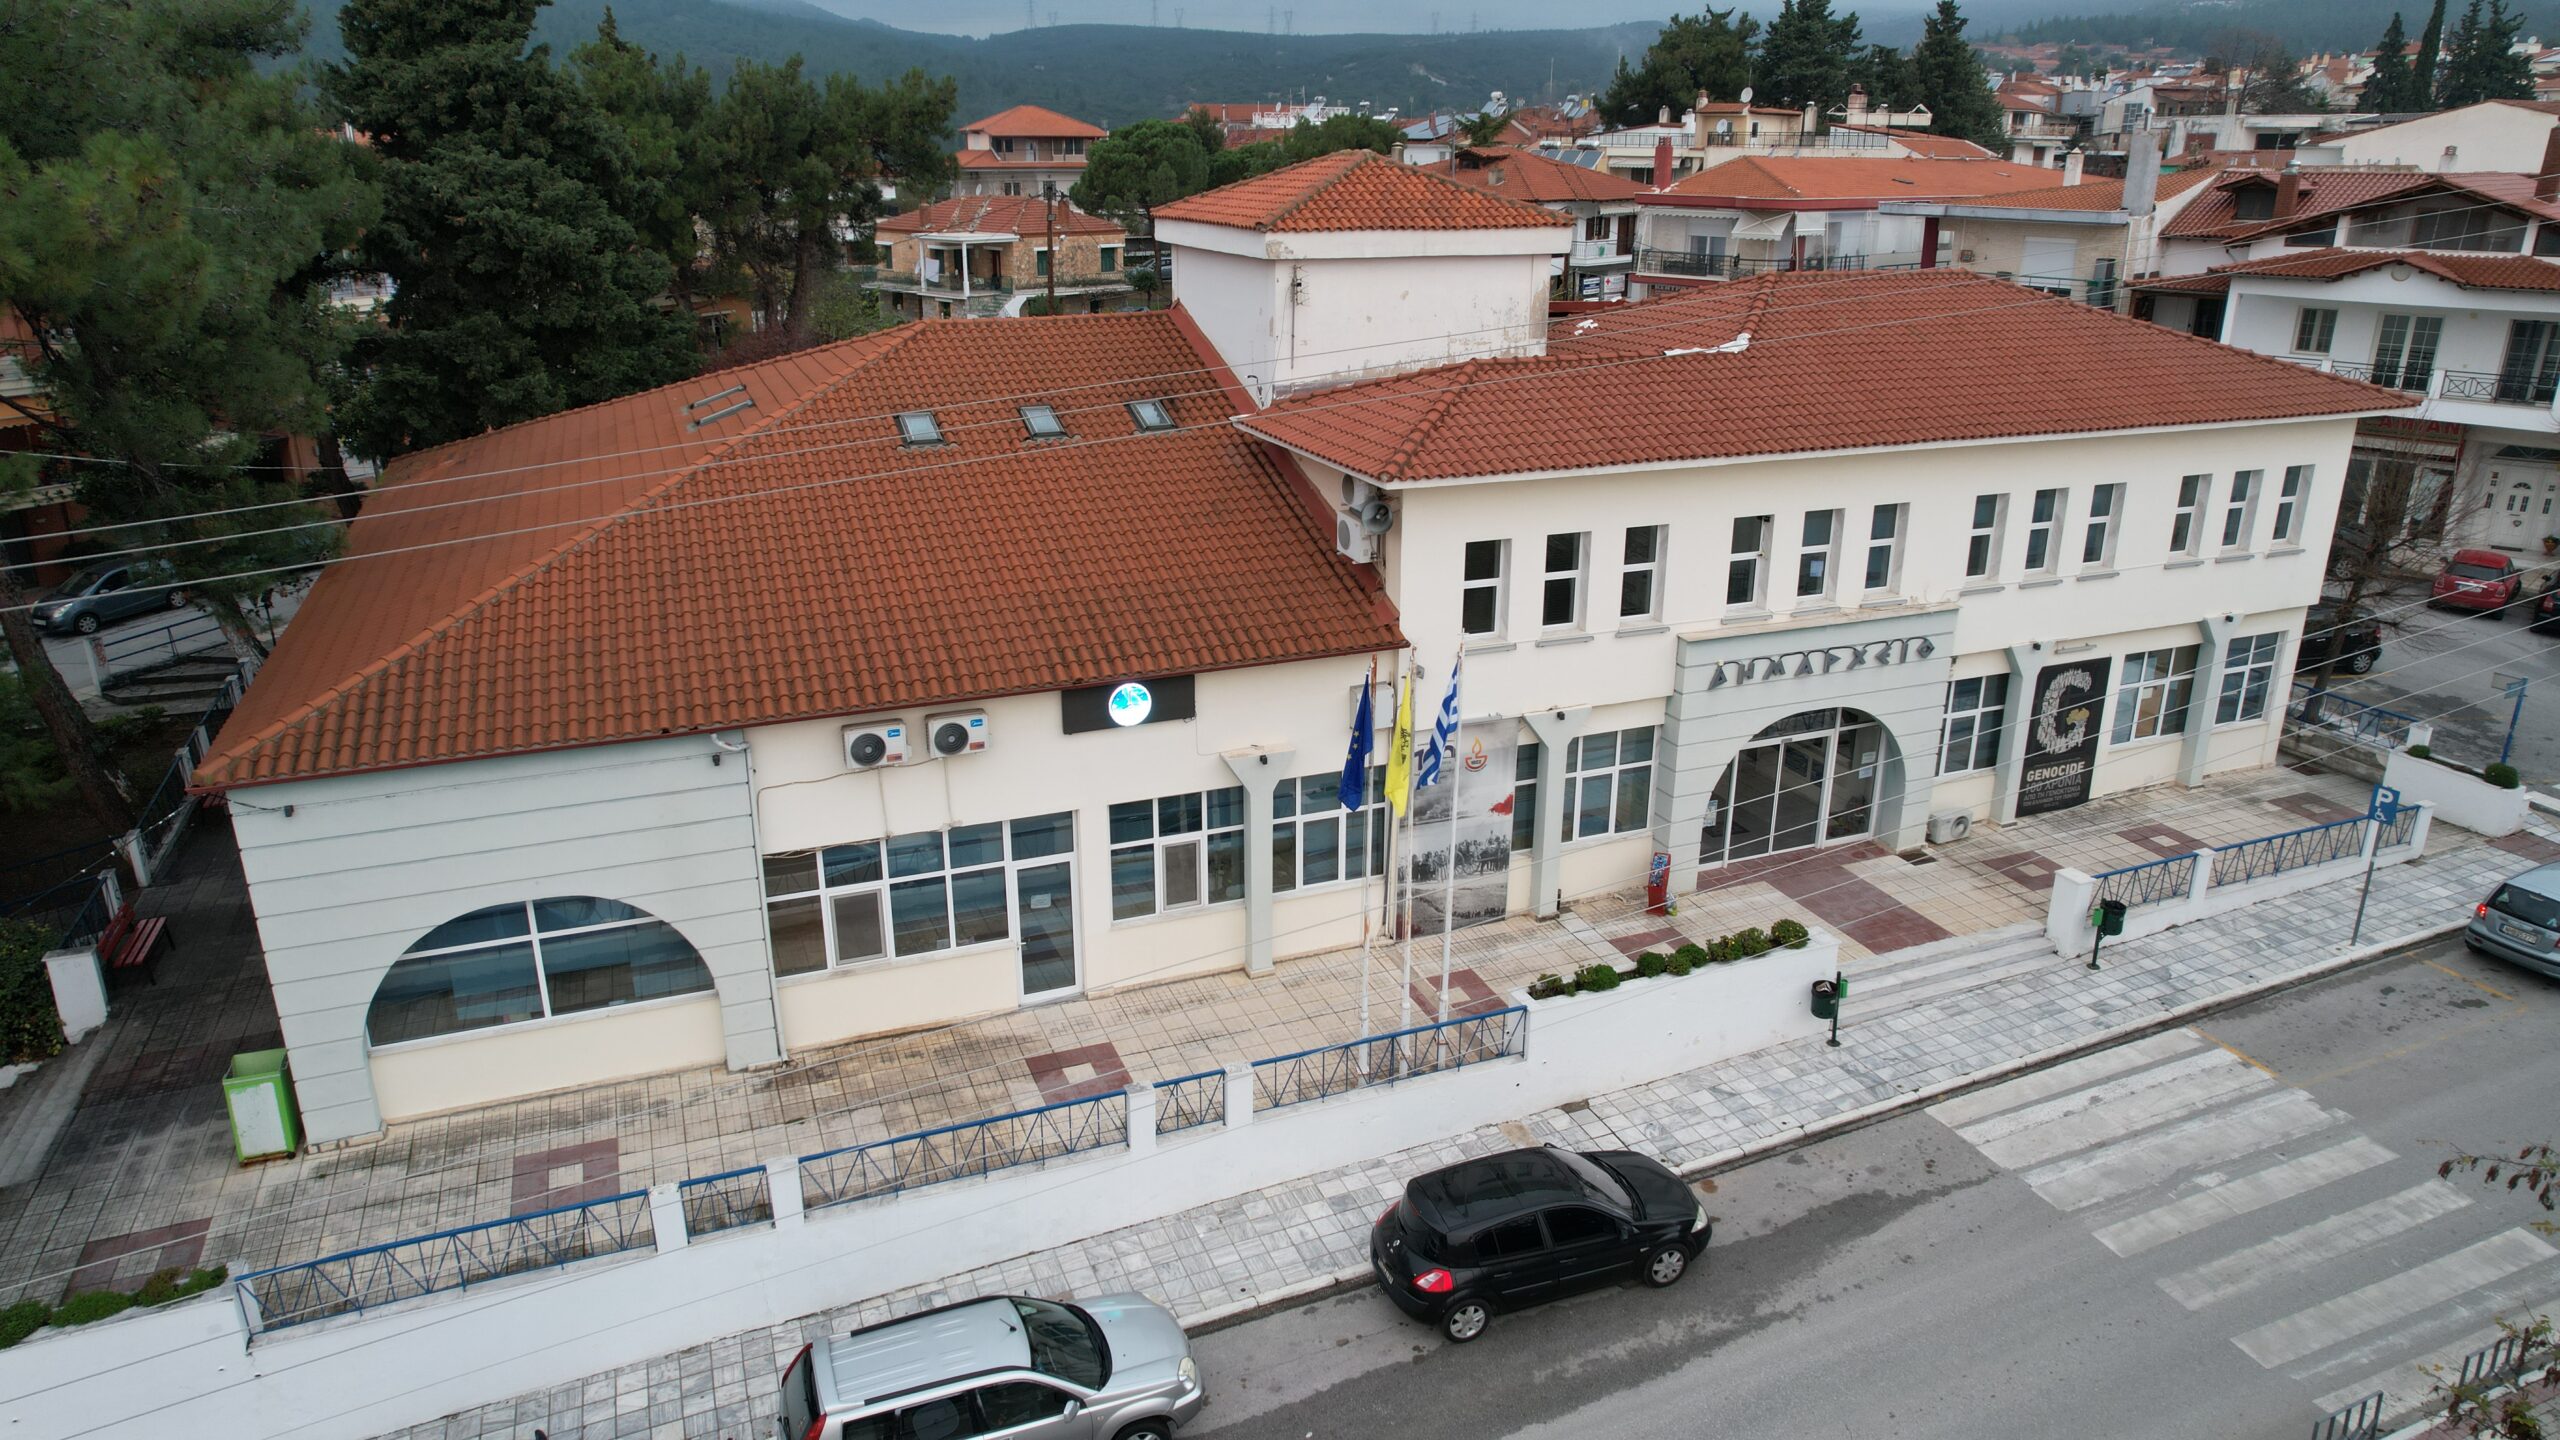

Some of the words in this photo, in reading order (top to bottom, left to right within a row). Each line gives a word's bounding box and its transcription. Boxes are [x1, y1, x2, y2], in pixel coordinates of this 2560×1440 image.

[1707, 637, 1935, 691] ΔΗΜΑΡΧΕΙΟ
[2026, 761, 2086, 782] GENOCIDE
[2044, 774, 2082, 790] ΧΡΟΝΙΑ
[2375, 788, 2394, 807] P
